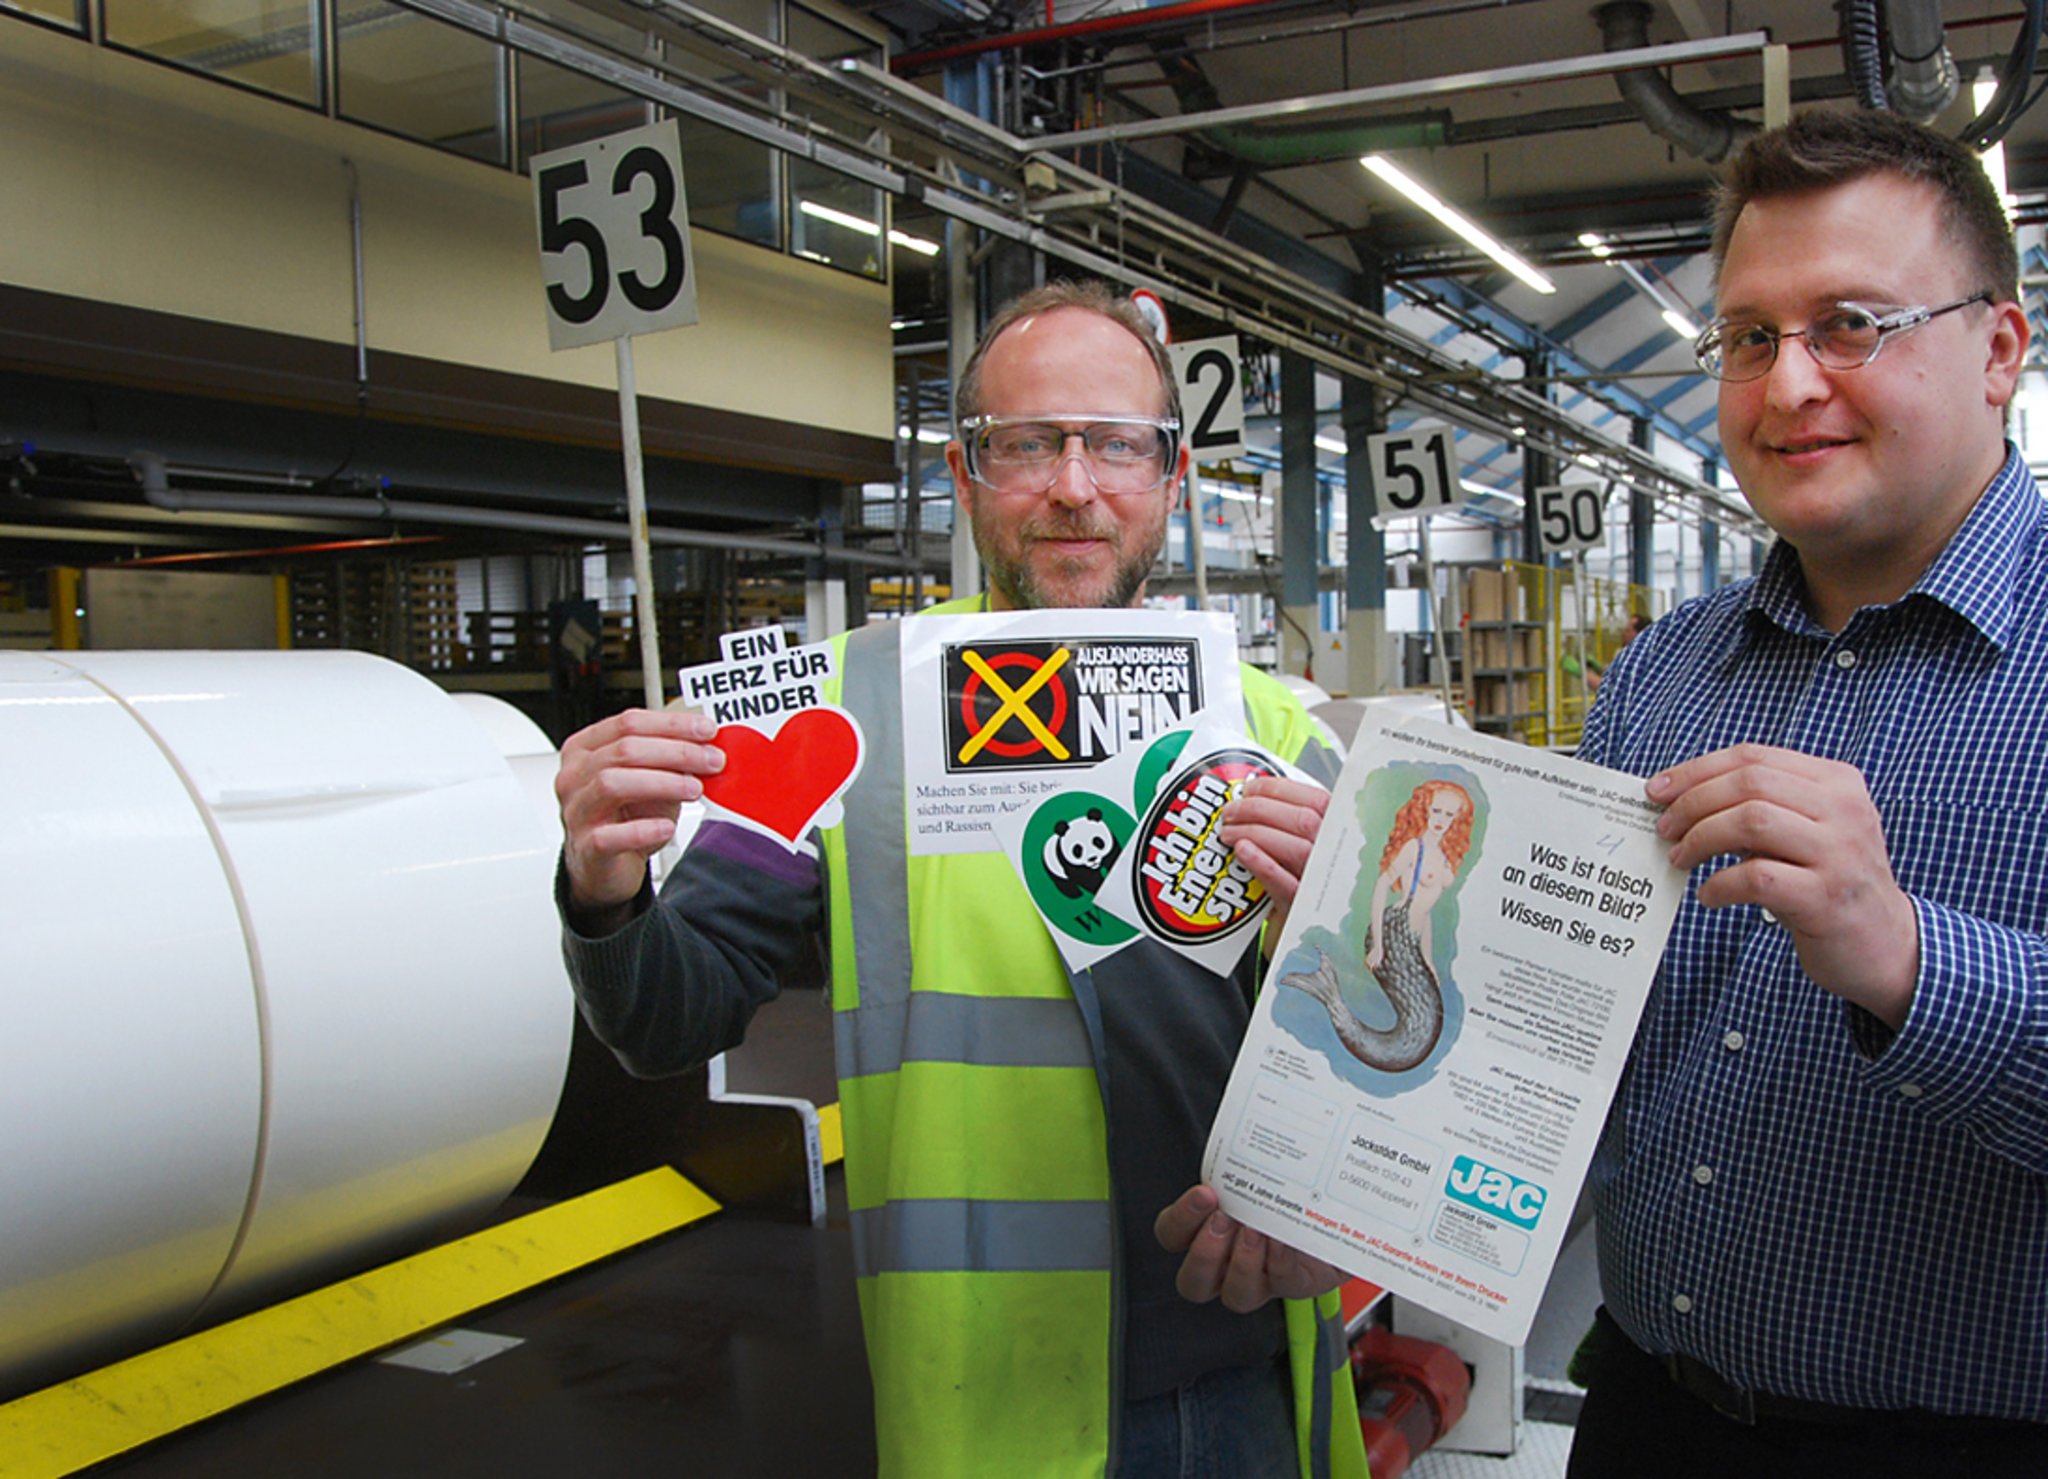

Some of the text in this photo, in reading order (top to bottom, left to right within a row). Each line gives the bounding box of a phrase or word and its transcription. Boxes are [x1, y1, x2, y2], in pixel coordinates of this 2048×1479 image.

[539, 146, 685, 324] 53
[1180, 349, 1240, 449] 2
[1385, 434, 1452, 510] 51
[1542, 489, 1601, 545] 50
[730, 632, 778, 661] EIN
[1076, 645, 1189, 665] AUSLÄNDERHASS
[690, 650, 829, 699] HERZ FÜR
[1076, 665, 1189, 694] WIR SAGEN
[713, 685, 818, 724] KINDER
[1078, 694, 1192, 757] NEIN
[1492, 758, 1504, 769] für
[1503, 761, 1522, 774] gute
[916, 785, 966, 798] Machen
[968, 783, 987, 796] Sie
[990, 783, 1015, 794] mit:
[1018, 782, 1037, 794] Sie
[917, 803, 964, 816] sichtbar
[967, 803, 995, 813] zum
[919, 822, 941, 834] und
[1141, 774, 1230, 885] Ich bin
[1530, 842, 1653, 899] Was ist falsch
[1502, 865, 1646, 923] an diesem Bild?
[1500, 897, 1635, 957] Wissen Sie es?
[1345, 1153, 1380, 1174] Postfach
[1351, 1134, 1431, 1175] Jackstädt GmbH
[1221, 1170, 1235, 1183] JAC
[1254, 1185, 1273, 1201] Jahre
[1371, 1183, 1410, 1209] Wuppertal
[1451, 1164, 1543, 1219] Jac
